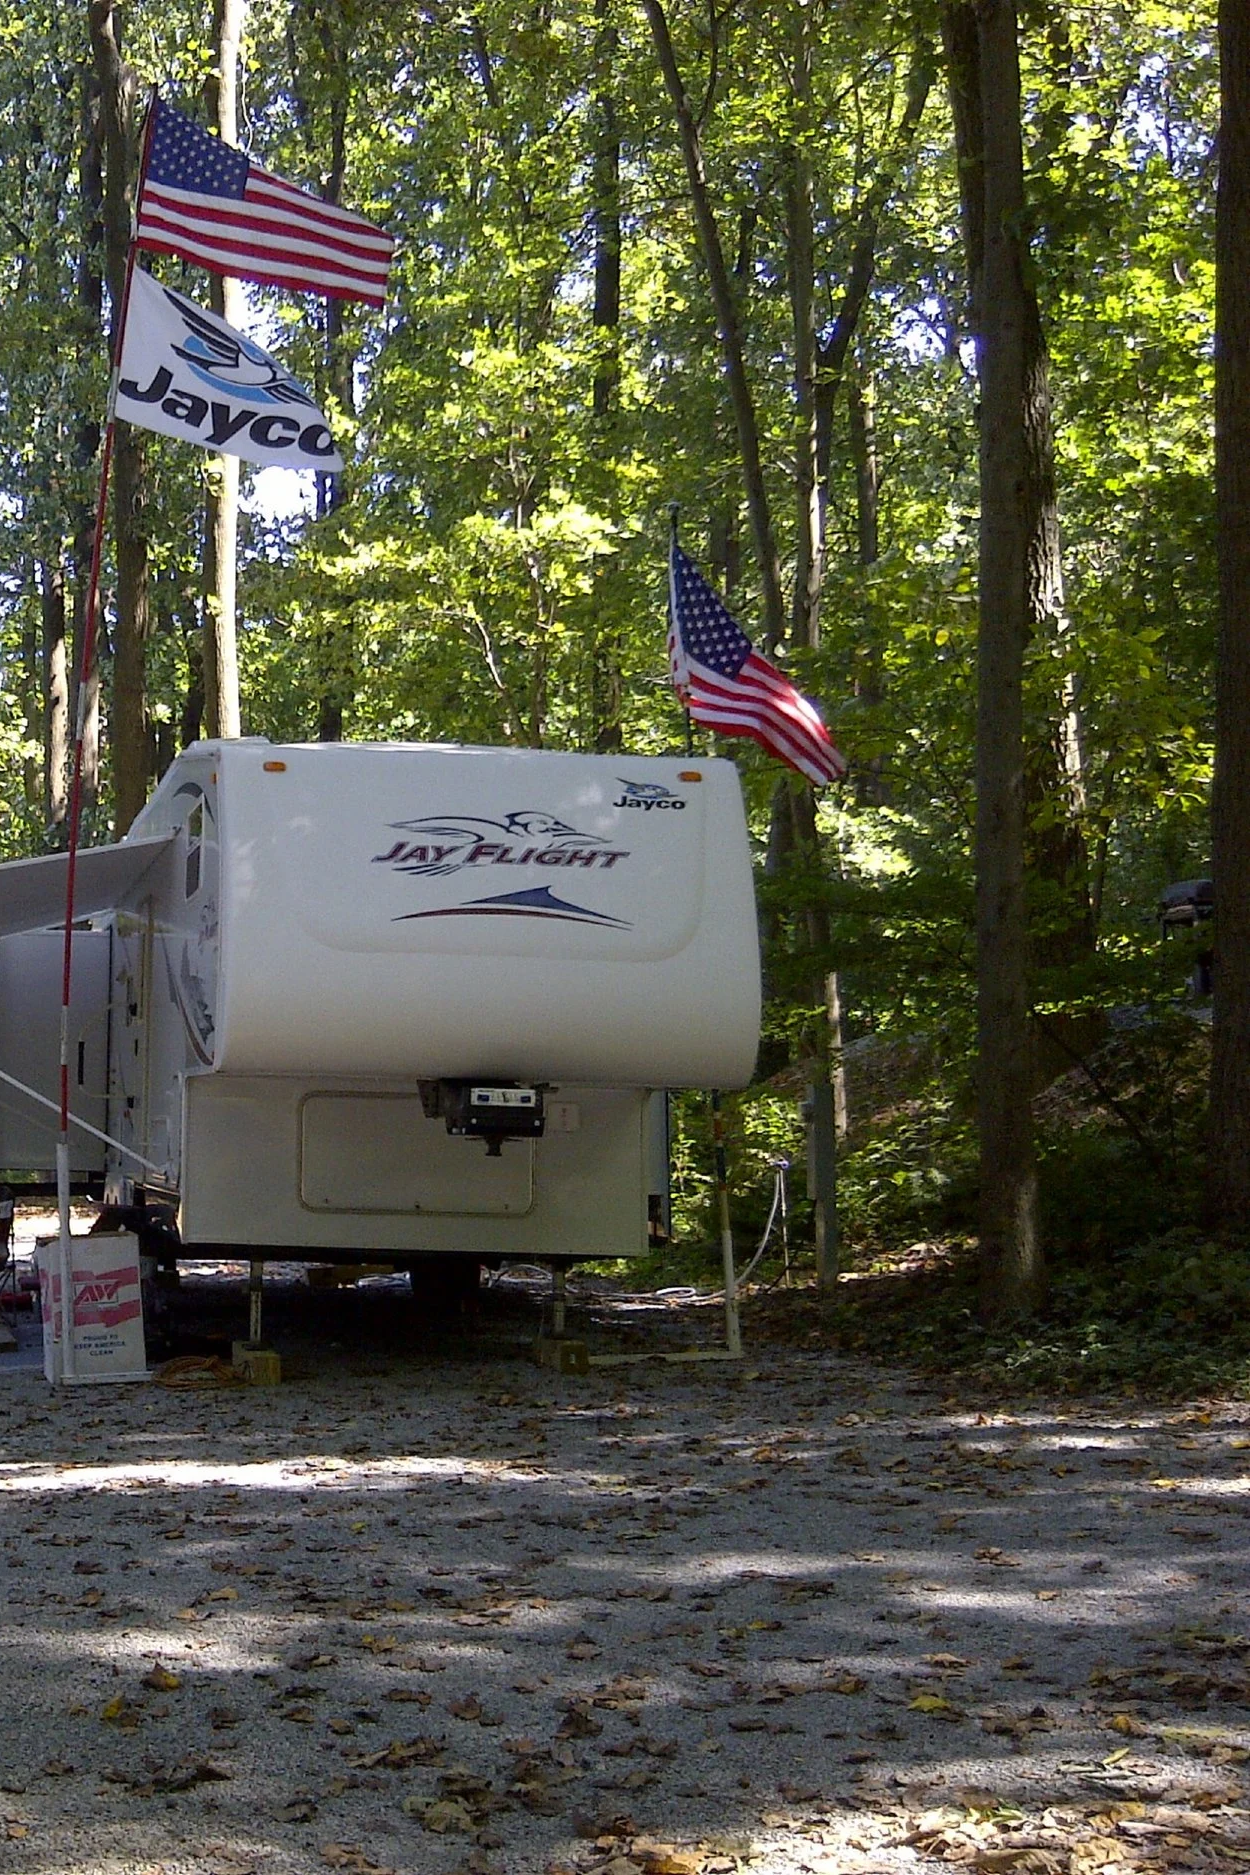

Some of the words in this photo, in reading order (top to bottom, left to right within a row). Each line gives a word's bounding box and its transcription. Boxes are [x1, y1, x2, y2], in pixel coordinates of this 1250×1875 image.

[118, 366, 335, 456] Jayco
[613, 795, 686, 811] Jayco
[371, 842, 463, 864] JAY
[463, 842, 630, 868] FLIGHT
